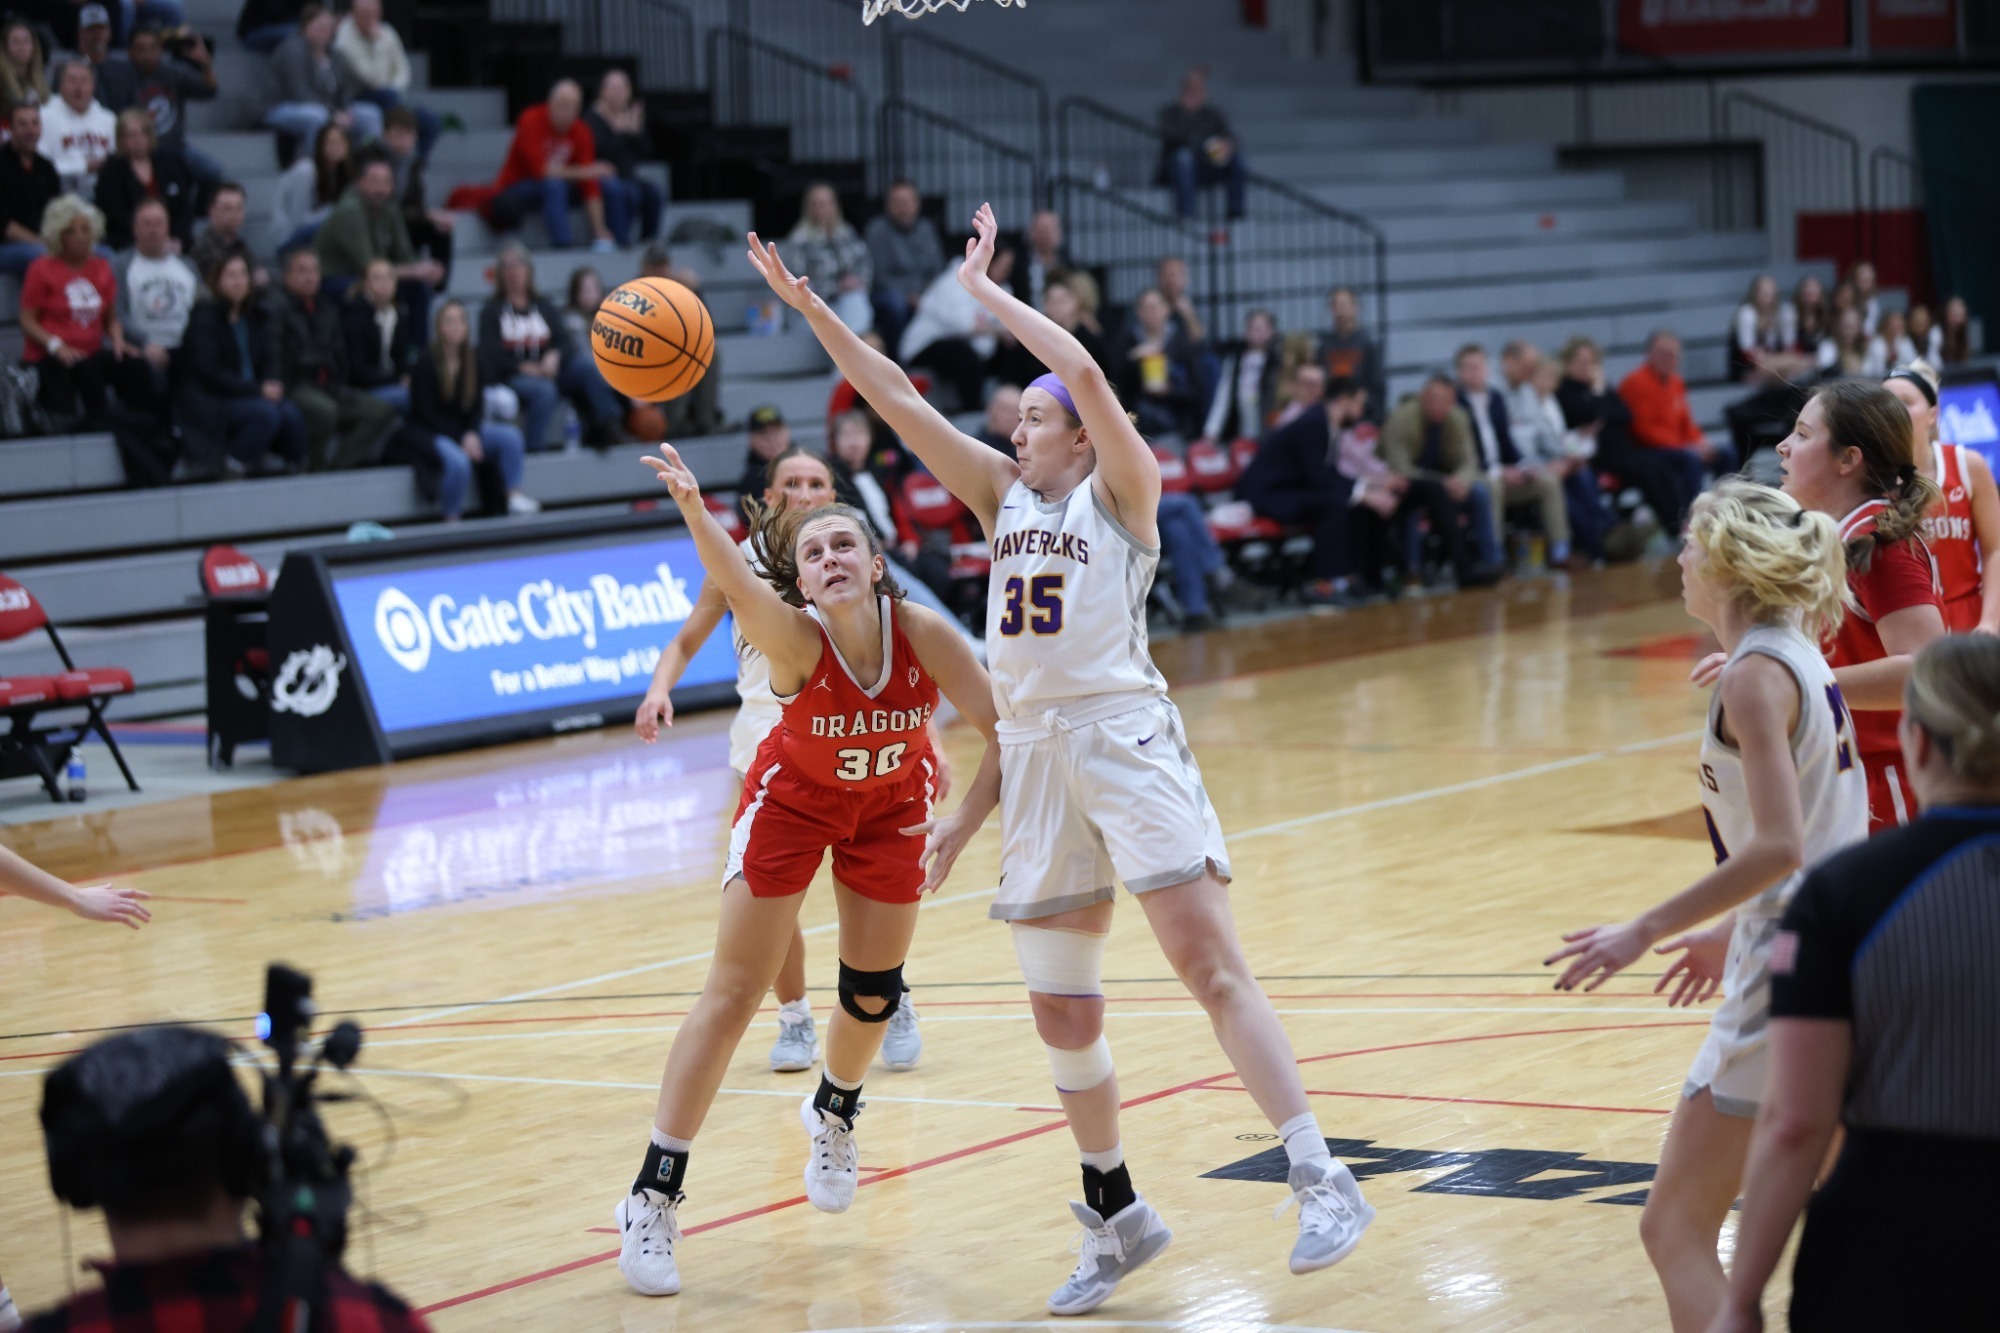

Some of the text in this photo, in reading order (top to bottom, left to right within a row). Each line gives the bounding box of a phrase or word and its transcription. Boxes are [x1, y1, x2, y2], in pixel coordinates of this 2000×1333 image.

[1921, 516, 1970, 540] GONS
[428, 562, 694, 651] Gate City Bank
[999, 573, 1065, 637] 35
[490, 669, 522, 696] For
[522, 670, 538, 691] a
[532, 663, 586, 689] Better
[581, 656, 621, 685] Way
[619, 648, 639, 677] of
[810, 702, 931, 738] DRAGONS
[835, 741, 908, 781] 30
